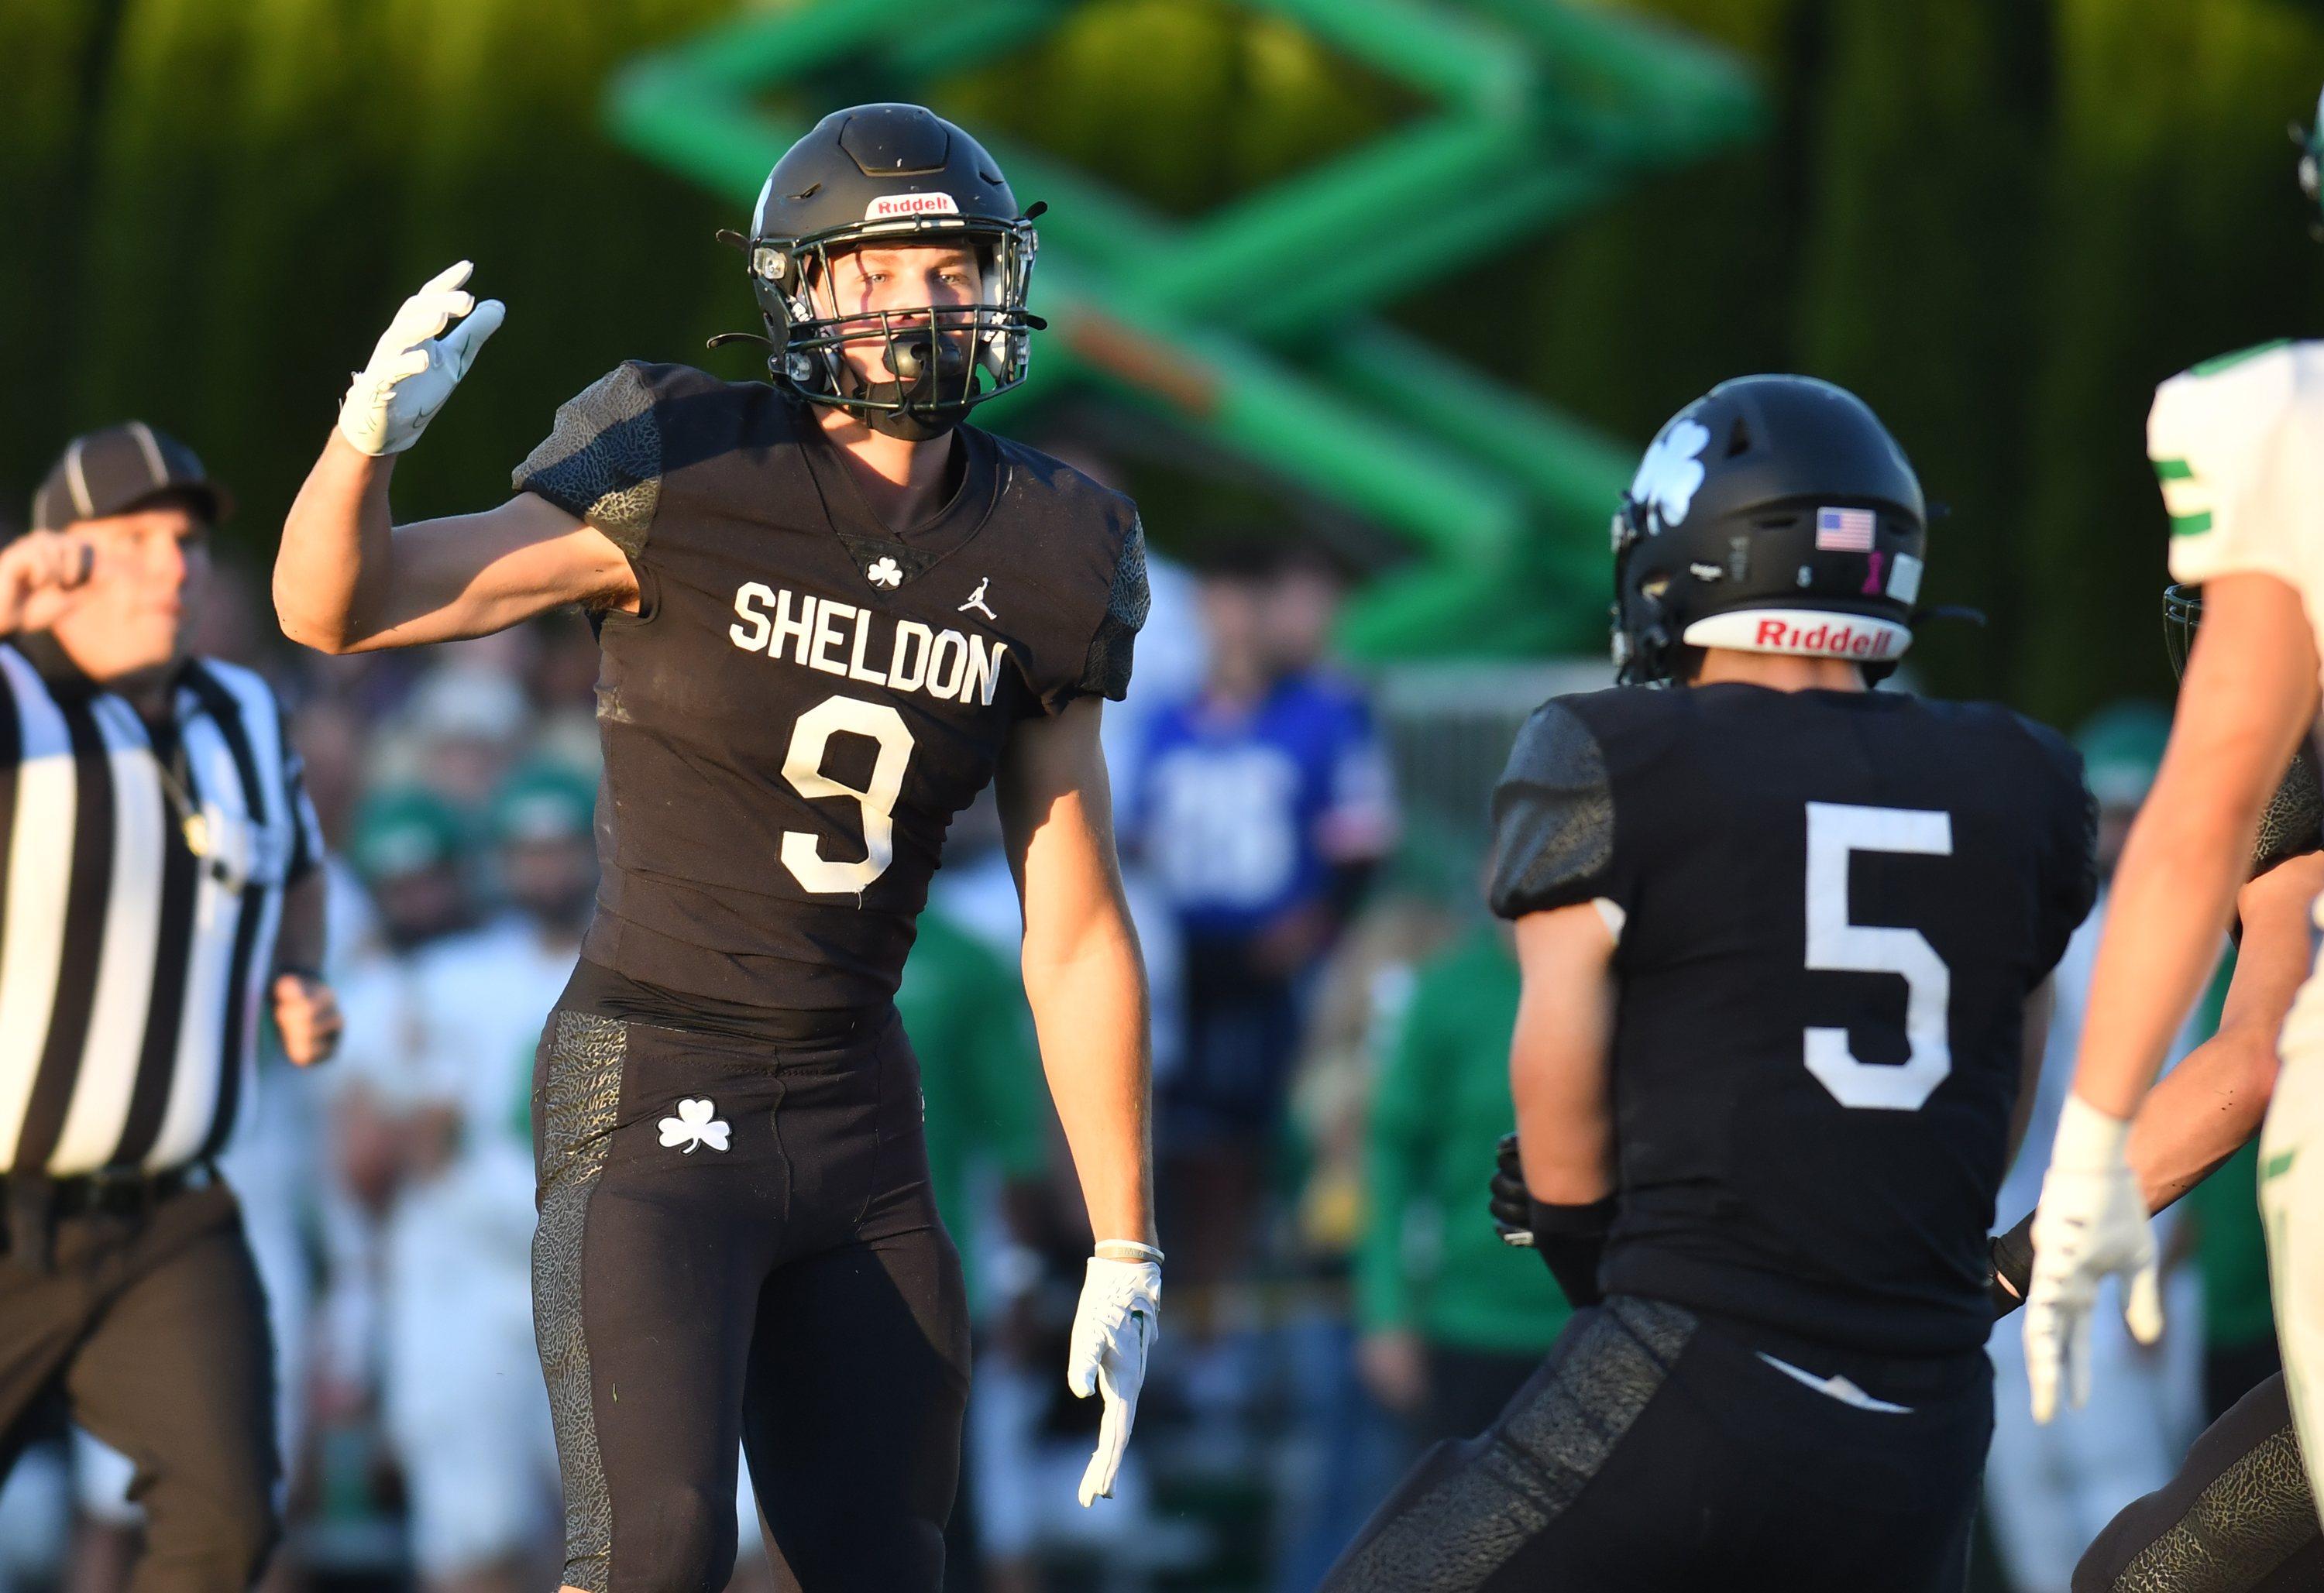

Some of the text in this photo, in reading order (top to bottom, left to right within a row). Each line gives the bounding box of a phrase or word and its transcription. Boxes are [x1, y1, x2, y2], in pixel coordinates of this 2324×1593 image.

[878, 197, 947, 214] Riddell
[729, 582, 1007, 706] SHELDON
[1757, 621, 1892, 655] Riddell
[781, 695, 915, 892] 9
[1803, 801, 1952, 1111] 5
